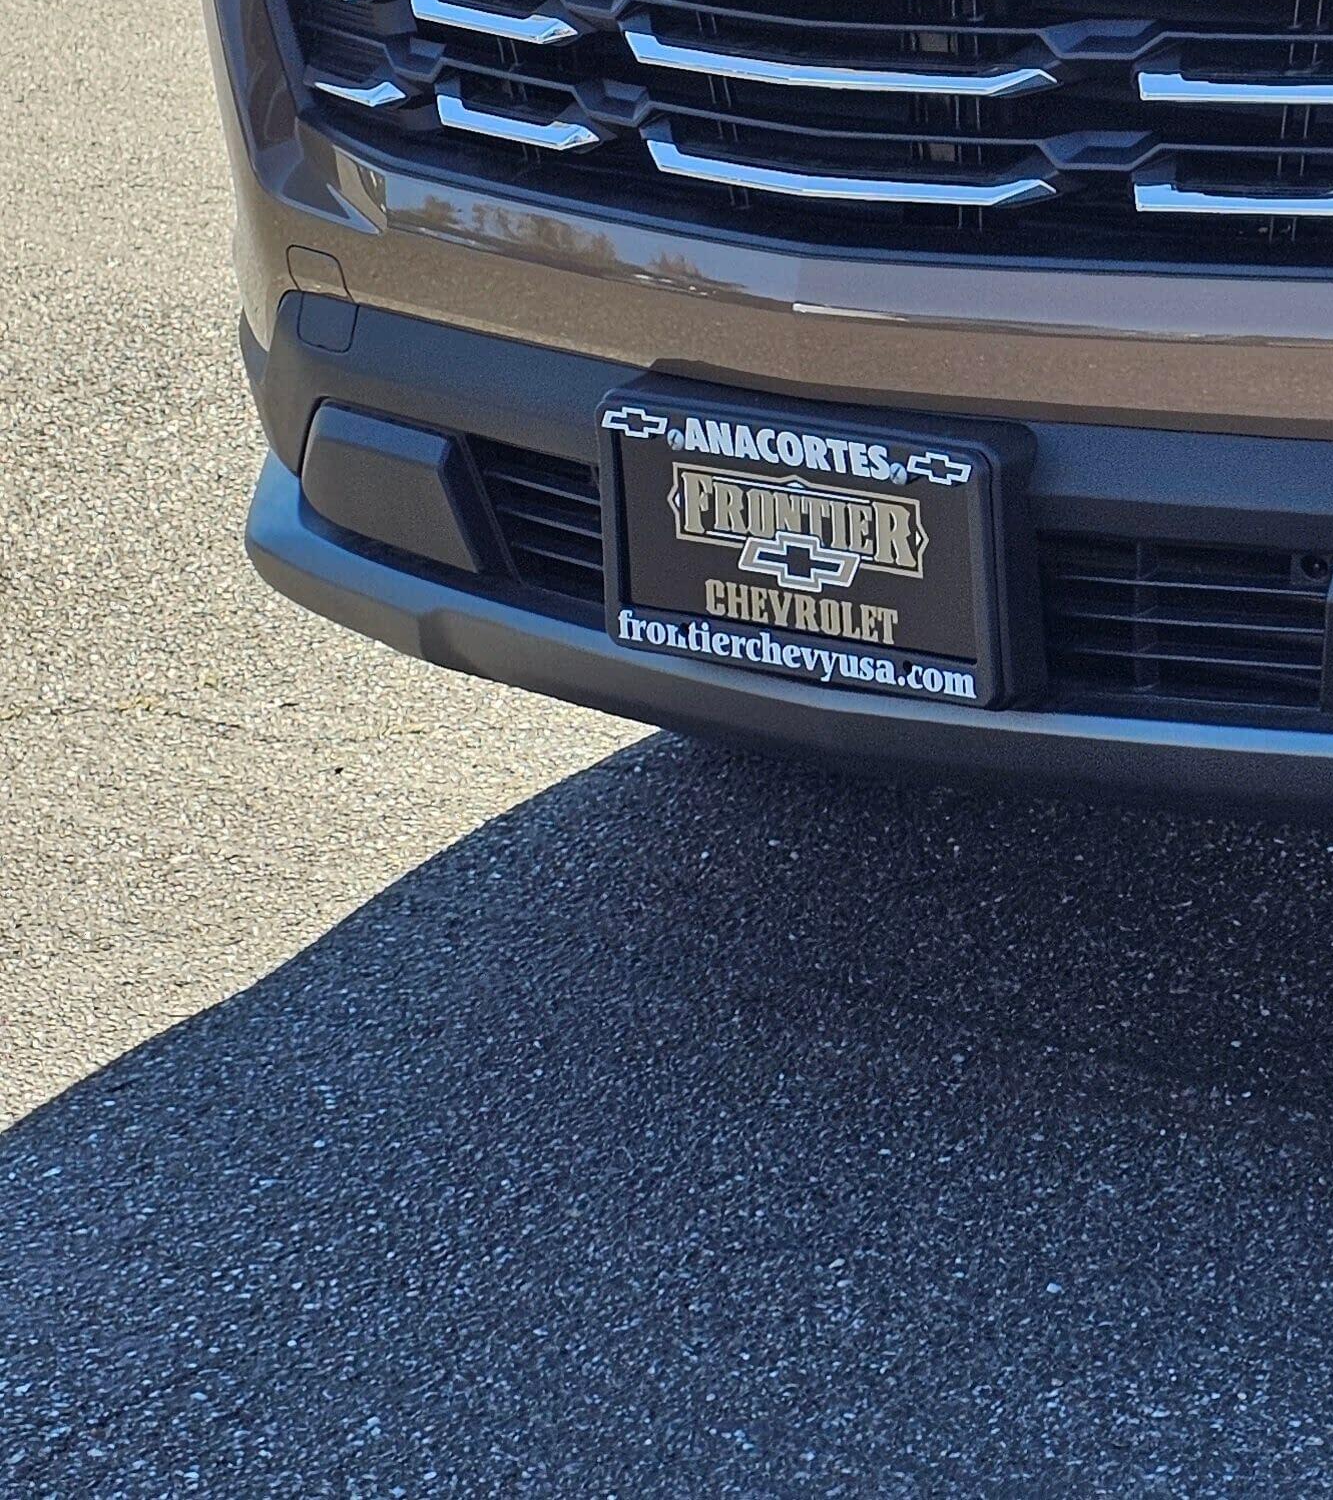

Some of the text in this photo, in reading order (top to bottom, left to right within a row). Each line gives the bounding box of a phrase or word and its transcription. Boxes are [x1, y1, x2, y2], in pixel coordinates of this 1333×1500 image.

[683, 416, 893, 481] ANACORTES
[681, 471, 917, 567] FRONTIER
[703, 578, 899, 645] CHEVROLET
[617, 609, 977, 700] frontierchevyusa.com
